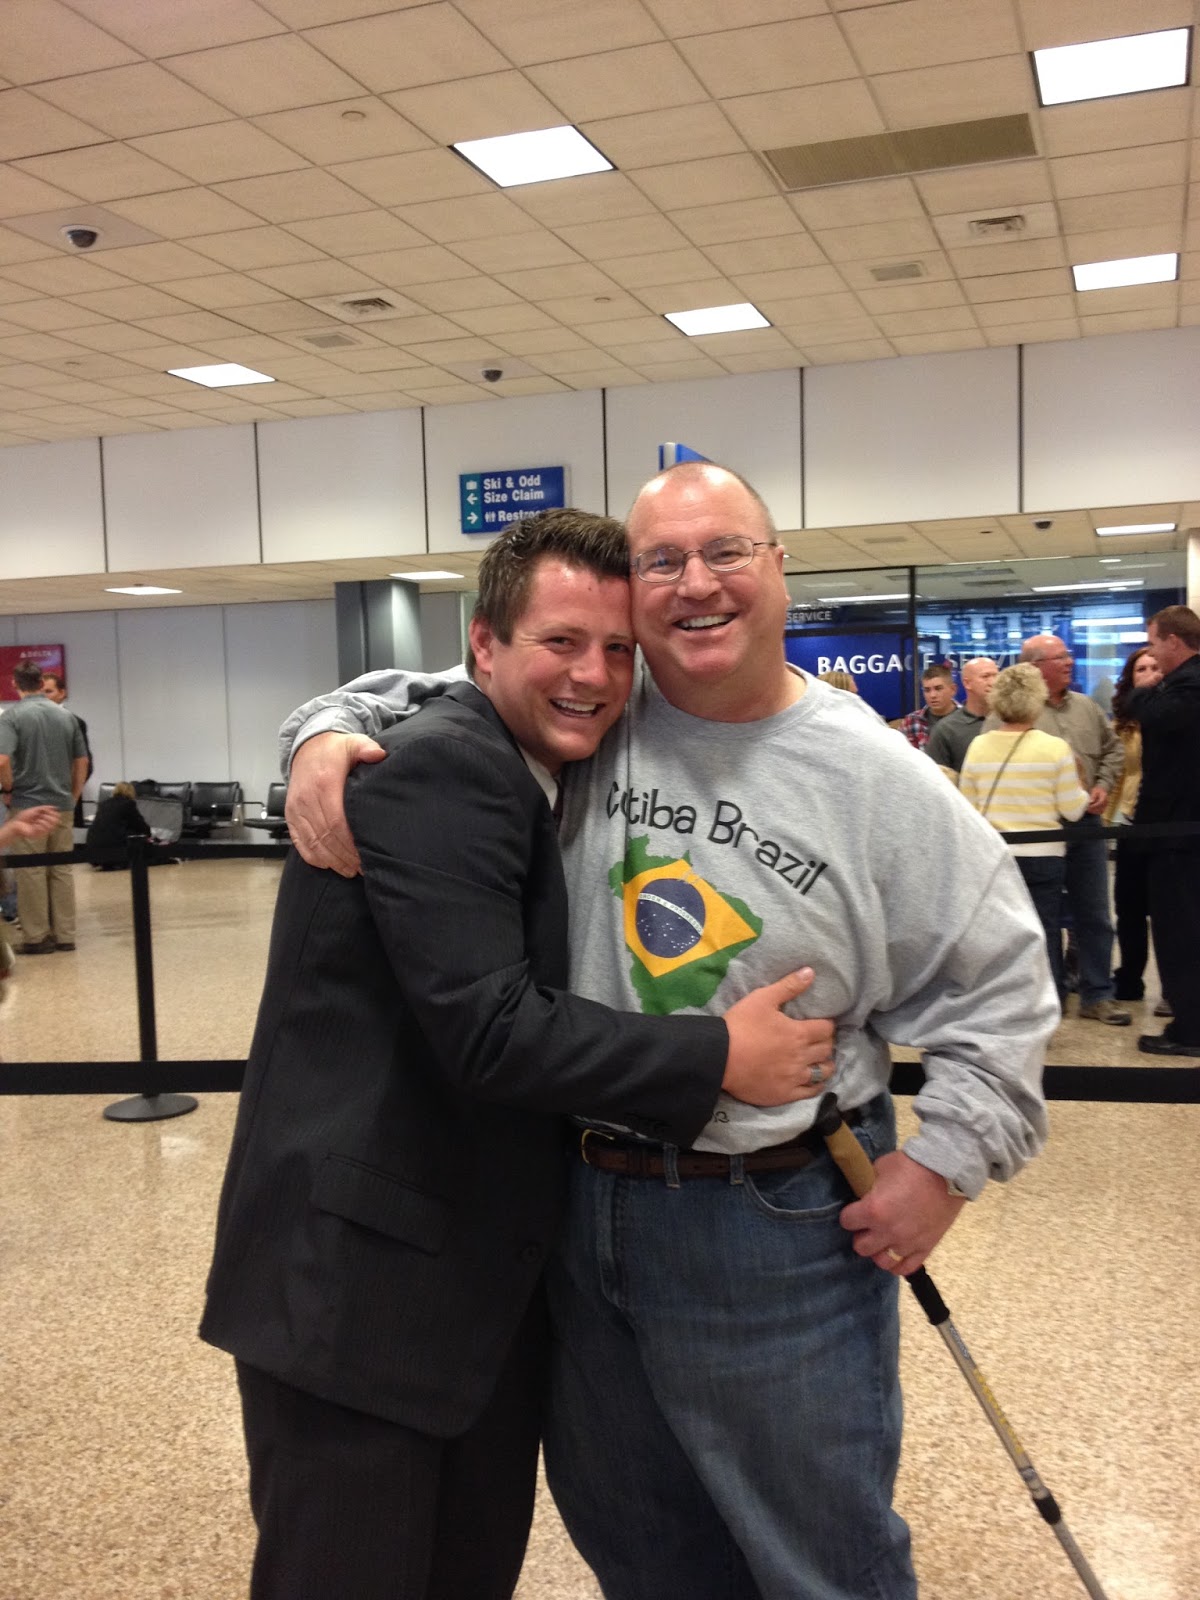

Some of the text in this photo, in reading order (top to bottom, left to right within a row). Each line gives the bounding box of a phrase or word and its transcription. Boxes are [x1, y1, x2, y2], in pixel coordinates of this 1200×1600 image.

[483, 474, 541, 490] Ski & Odd
[484, 489, 544, 504] Size Claim
[498, 510, 542, 522] Restro
[786, 610, 832, 623] SERVICE
[707, 800, 828, 895] Brazil
